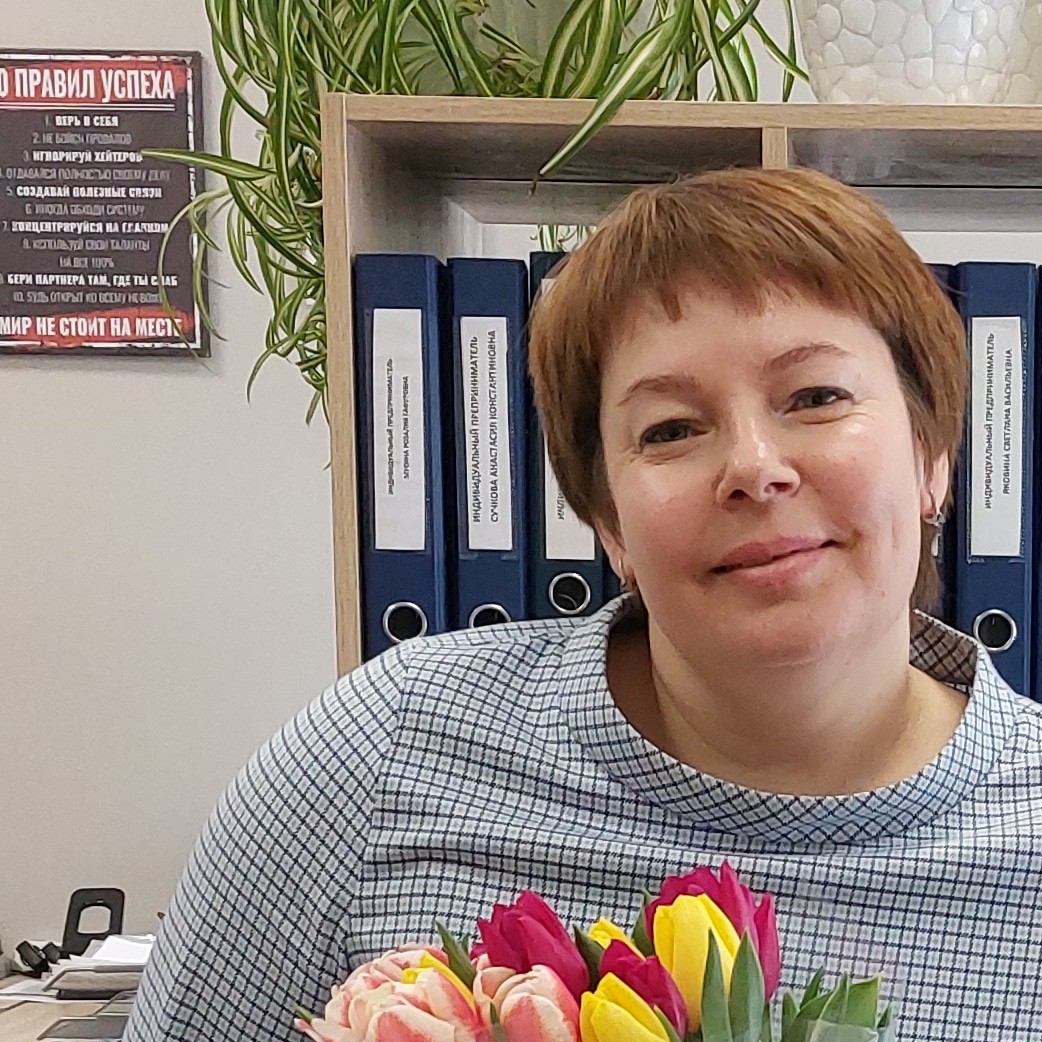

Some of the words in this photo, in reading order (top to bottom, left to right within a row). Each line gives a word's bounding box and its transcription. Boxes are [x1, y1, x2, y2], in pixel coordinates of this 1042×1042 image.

[14, 68, 96, 98] ПРАВИЛ
[100, 68, 176, 103] УСПЕХА
[55, 115, 81, 127] ВЕРЬ
[93, 116, 119, 127] СЕБЯ
[32, 149, 92, 164] ИГНОРИРУЙ
[94, 149, 143, 163] ХЕЙТЕРОВ
[16, 184, 70, 199] СОЗДАВАЙ
[72, 186, 126, 198] ПОЛЕЗНЫЕ
[11, 220, 103, 235] КОНЦЕНТРИРУЙСЯ
[106, 222, 119, 233] НА
[7, 274, 33, 286] БЕРИ
[35, 274, 85, 287] ПАРТНЕРА
[112, 274, 131, 288] ГДЕ
[132, 274, 149, 286] ТЫ
[0, 316, 32, 336] МИР
[36, 316, 56, 336] НЕ
[59, 317, 107, 337] СТОИТ
[110, 318, 133, 337] НА
[487, 330, 498, 420] КОНСТАНТИНОВНА
[985, 332, 995, 422] ПРЕДПРИНИМАТЕЛЬ
[1003, 348, 1013, 406] ВАСИЛЬЕВНА
[488, 421, 498, 478] АНАСТАСИЯ
[1003, 407, 1012, 452] СВЕТЛАНА
[469, 428, 482, 523] ИНДИВИДУАЛЬНЫЙ
[983, 423, 994, 510] ИНДИВИДУАЛЬНЫЙ
[489, 478, 499, 523] СУЧКОВА
